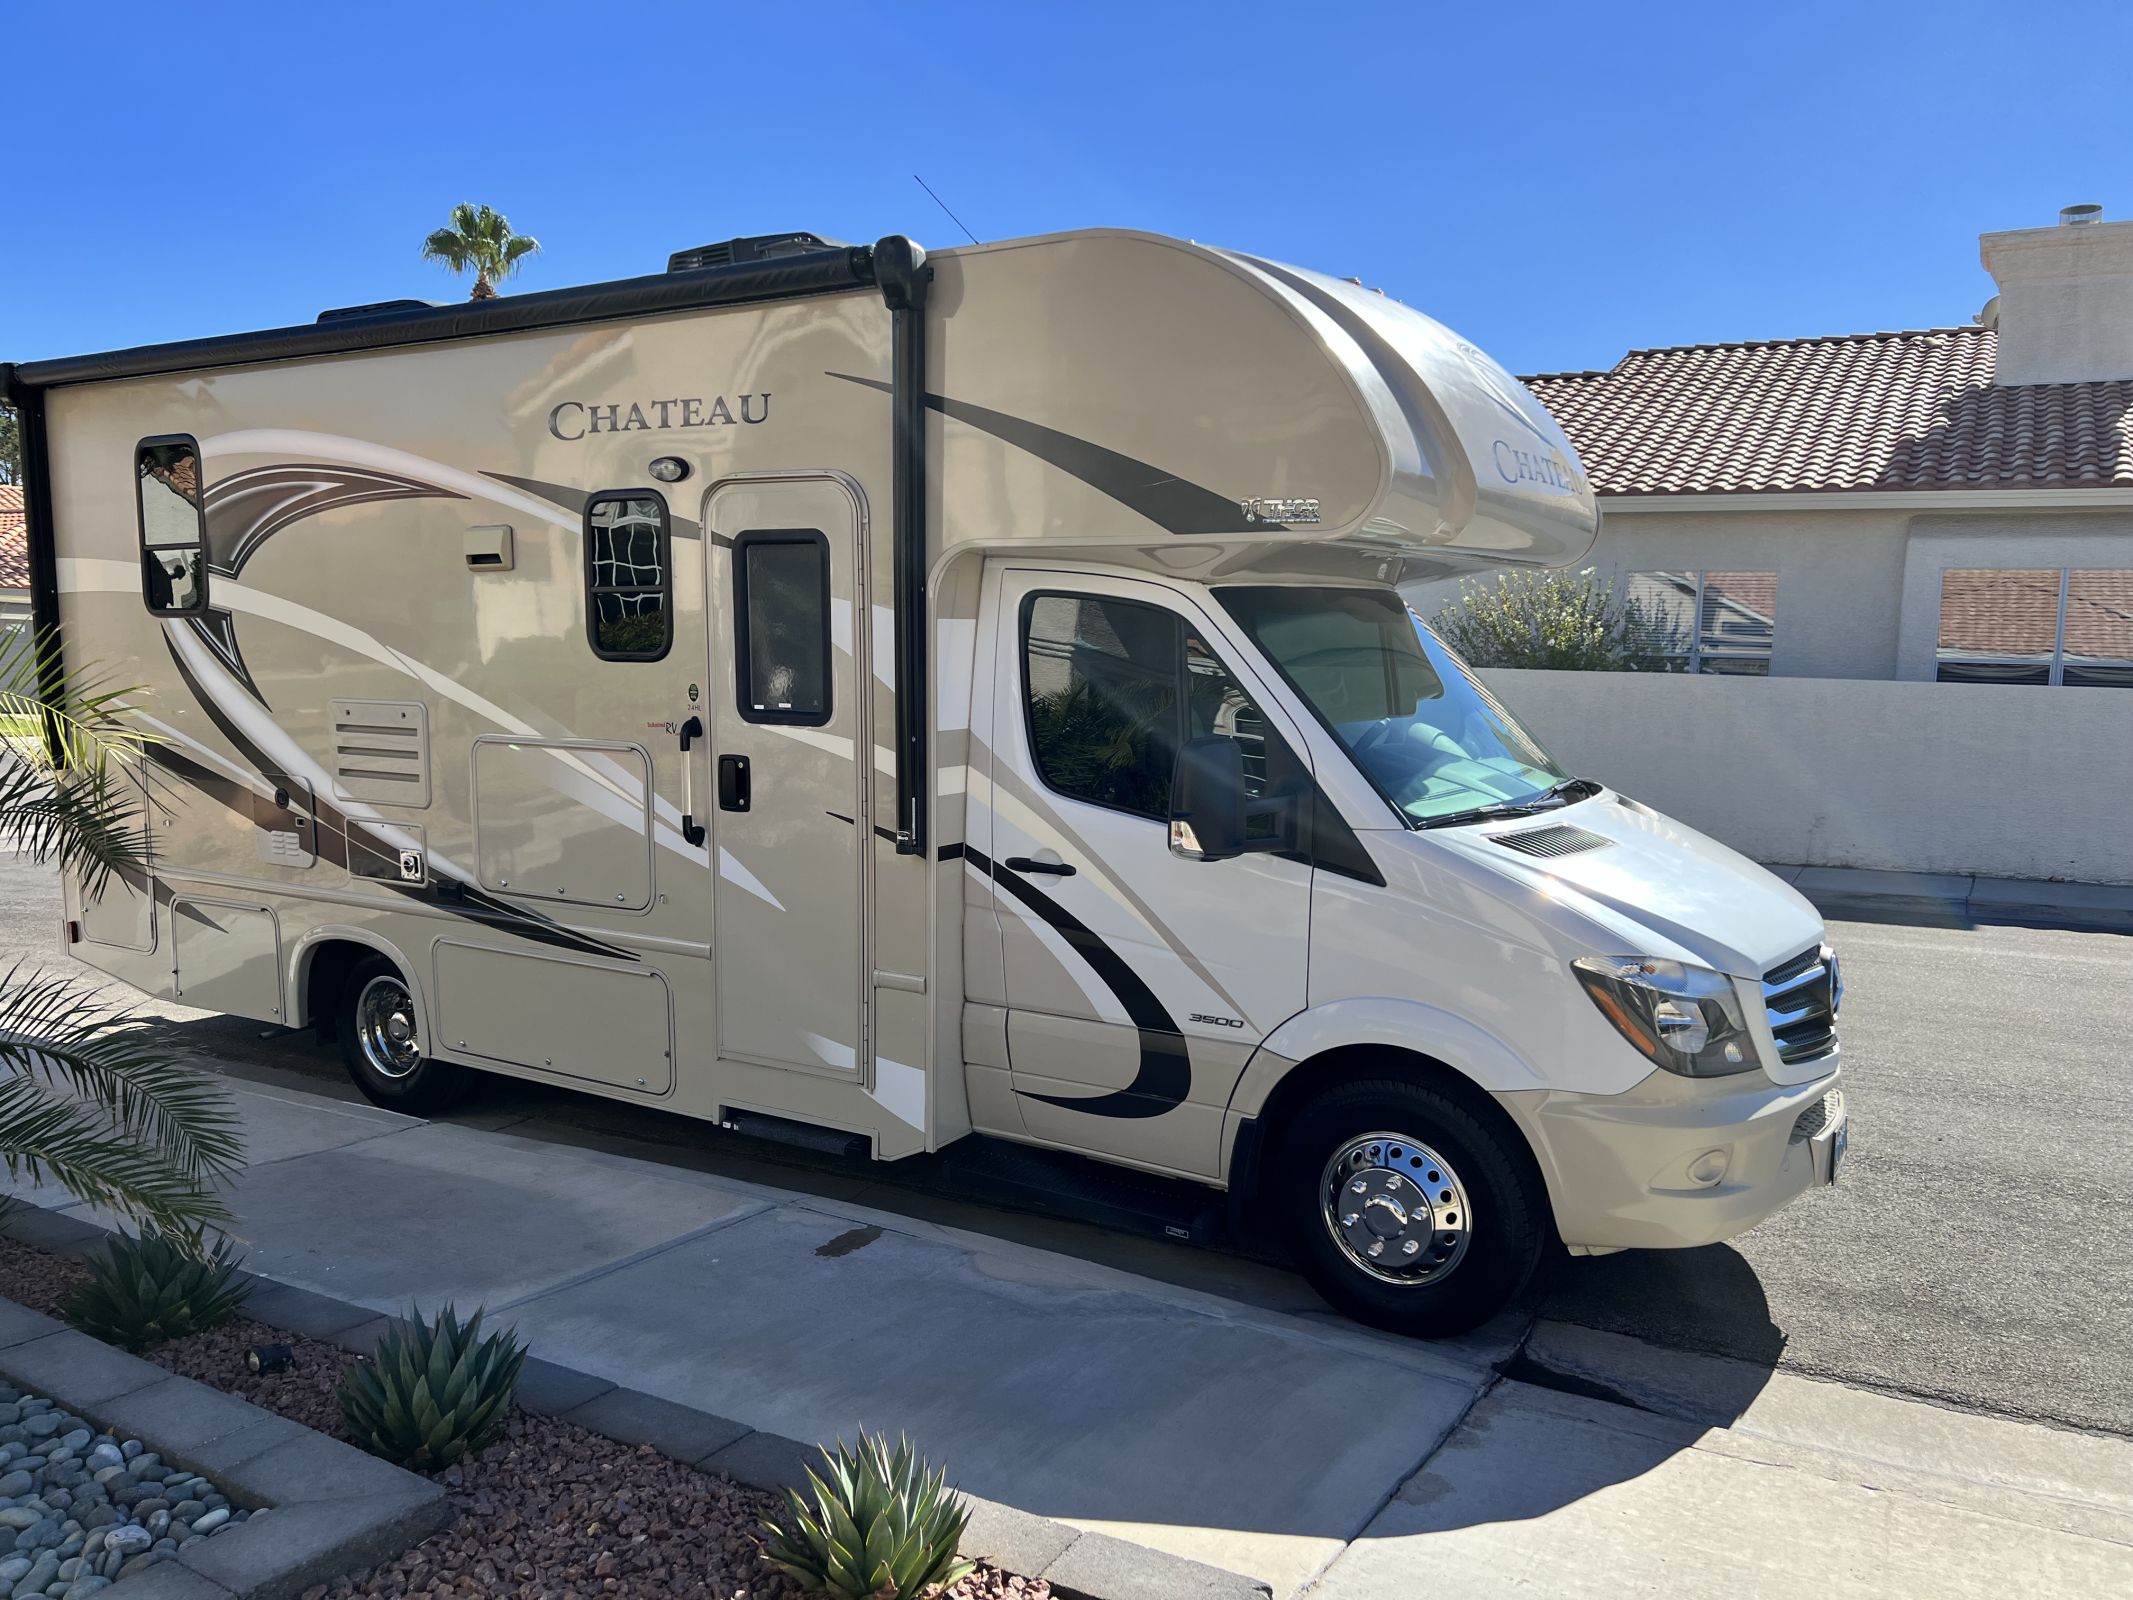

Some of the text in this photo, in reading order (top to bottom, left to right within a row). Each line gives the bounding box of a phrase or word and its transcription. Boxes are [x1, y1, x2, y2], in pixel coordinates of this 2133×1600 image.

[548, 393, 771, 441] CHATEAU
[1492, 440, 1585, 495] CHATEAU
[1263, 499, 1320, 517] THOR
[1188, 1013, 1245, 1029] 3500
